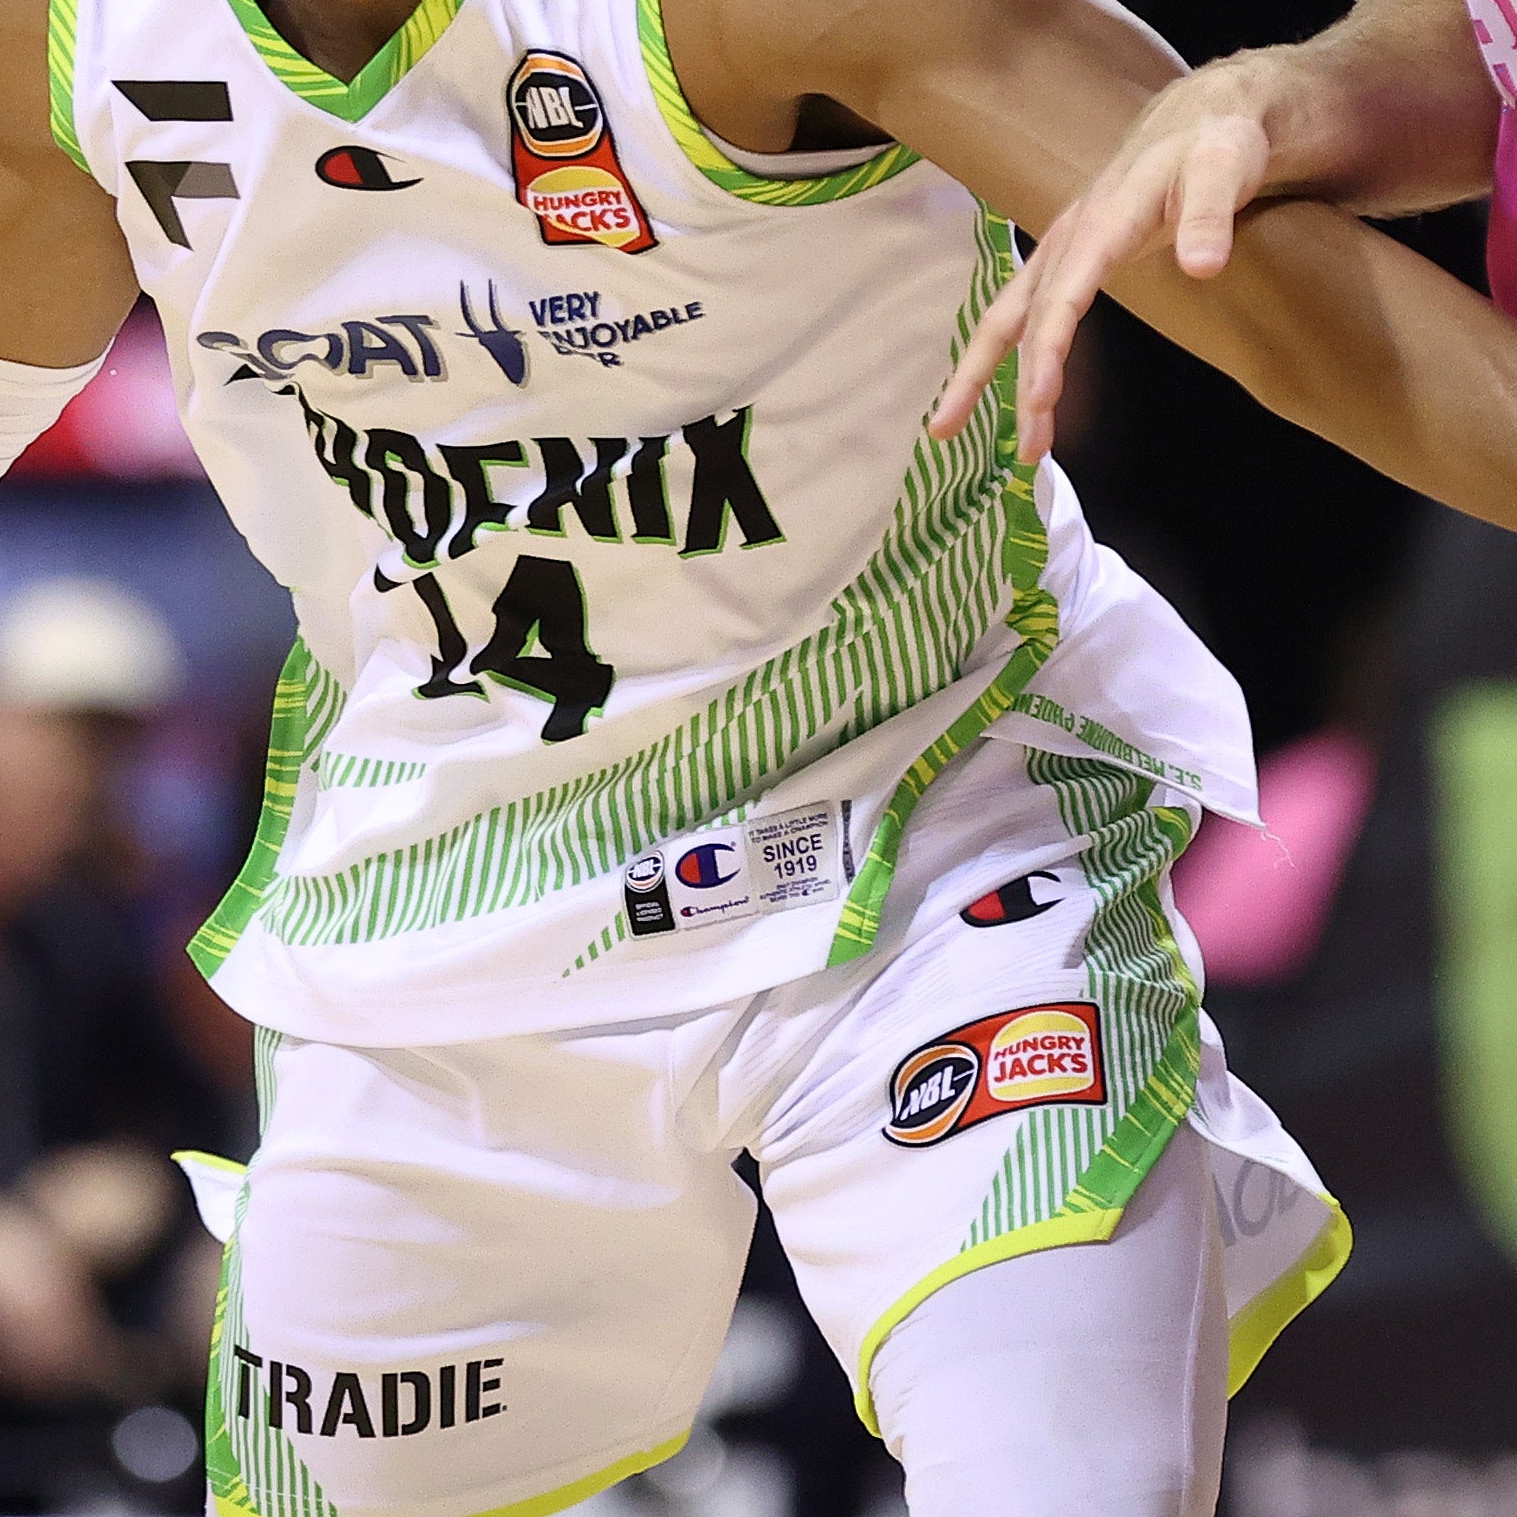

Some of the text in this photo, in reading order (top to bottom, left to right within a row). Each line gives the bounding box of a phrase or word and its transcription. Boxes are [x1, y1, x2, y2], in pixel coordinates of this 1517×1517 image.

[526, 86, 584, 129] NBL
[534, 190, 622, 211] HUNGRY
[529, 291, 600, 327] VERY
[373, 555, 614, 742] 14
[763, 833, 823, 863] SINCE
[774, 855, 817, 880] 1919
[680, 897, 747, 918] Champion
[994, 1035, 1084, 1062] HUNGRY
[900, 1065, 956, 1121] NBL
